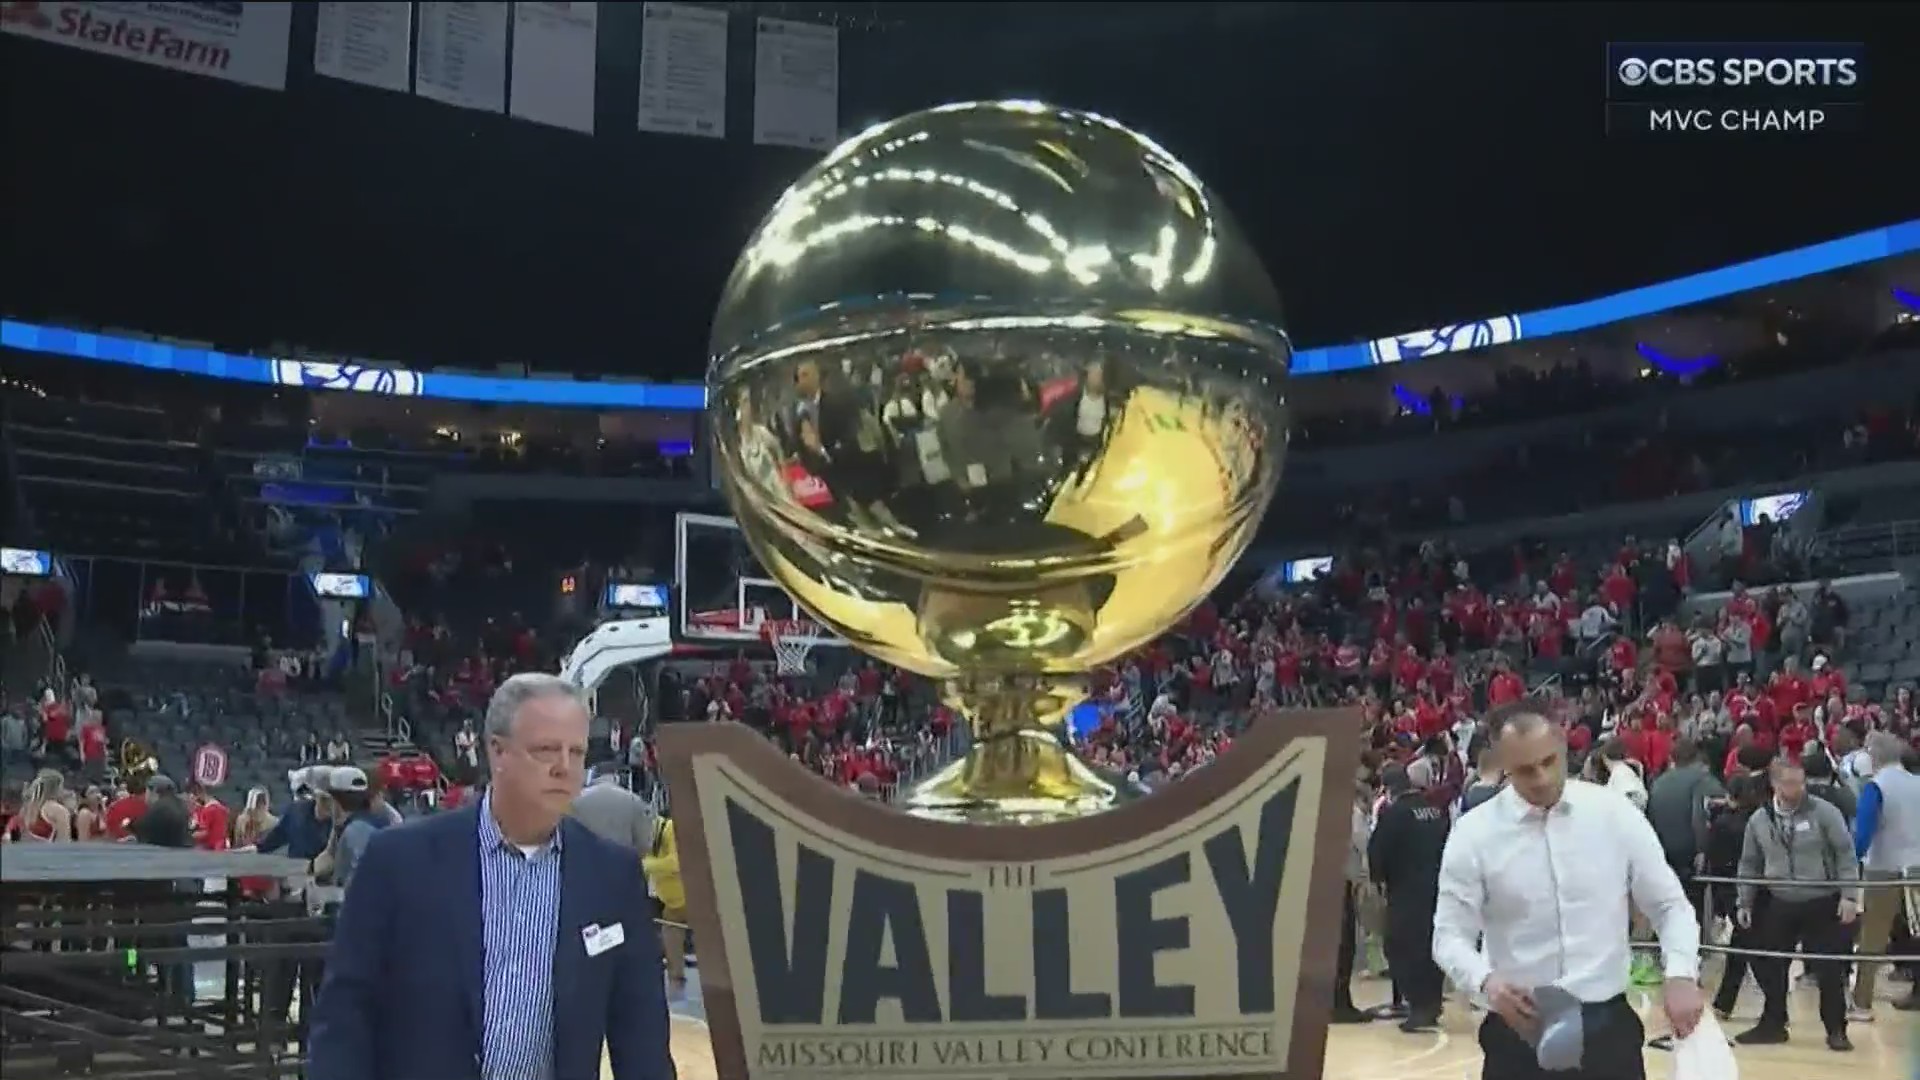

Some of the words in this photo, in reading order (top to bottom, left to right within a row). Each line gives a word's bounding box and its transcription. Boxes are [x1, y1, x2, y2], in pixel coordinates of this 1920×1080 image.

[725, 773, 1302, 1024] VALLEY
[757, 1038, 919, 1067] MISSOURI
[933, 1037, 1054, 1064] VALLEY
[1065, 1030, 1271, 1062] CONFERENCE
